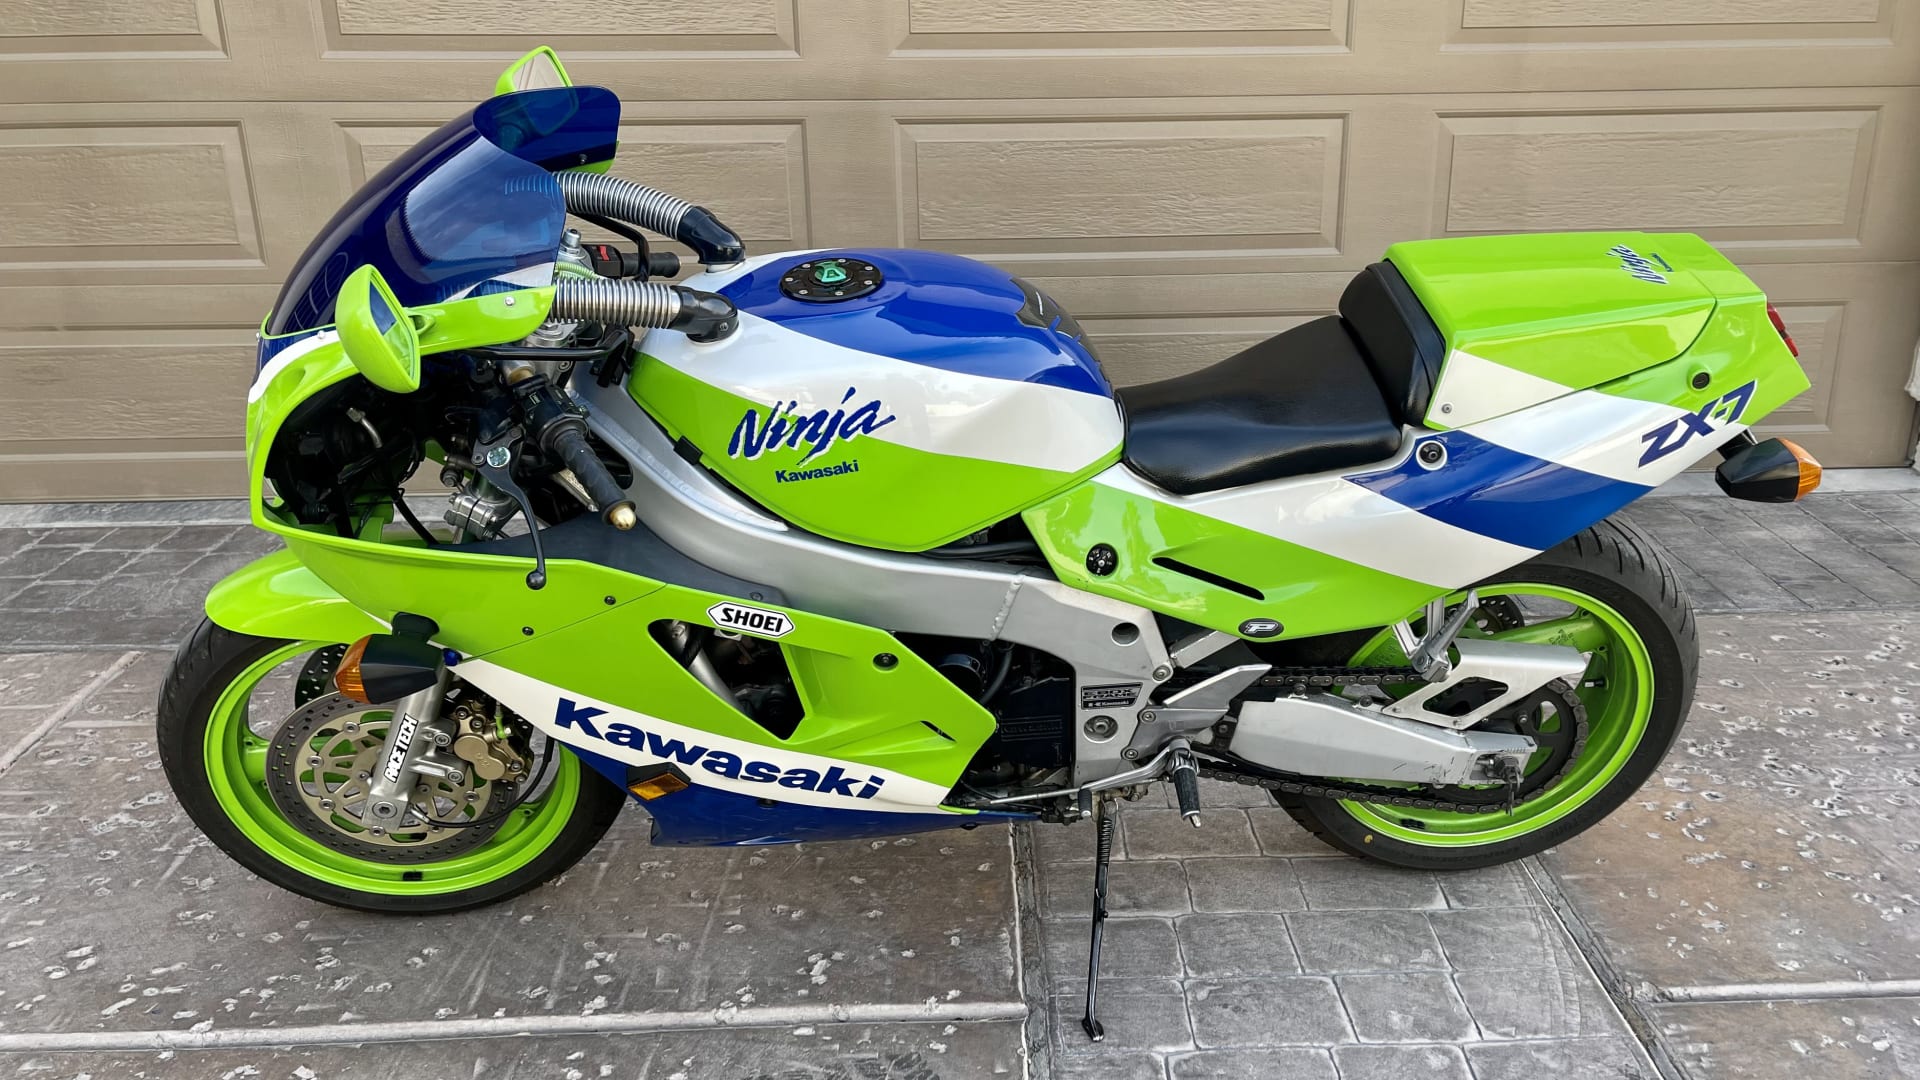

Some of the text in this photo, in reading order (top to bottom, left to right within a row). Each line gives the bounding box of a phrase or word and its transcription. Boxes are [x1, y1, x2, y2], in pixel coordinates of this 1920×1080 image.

[728, 386, 896, 467] Ninja
[1638, 380, 1757, 467] ZX-7
[775, 459, 860, 483] Kawasaki
[720, 607, 784, 633] SHOEI
[384, 713, 418, 783] RACE TECH
[554, 697, 886, 800] Kawasaki
